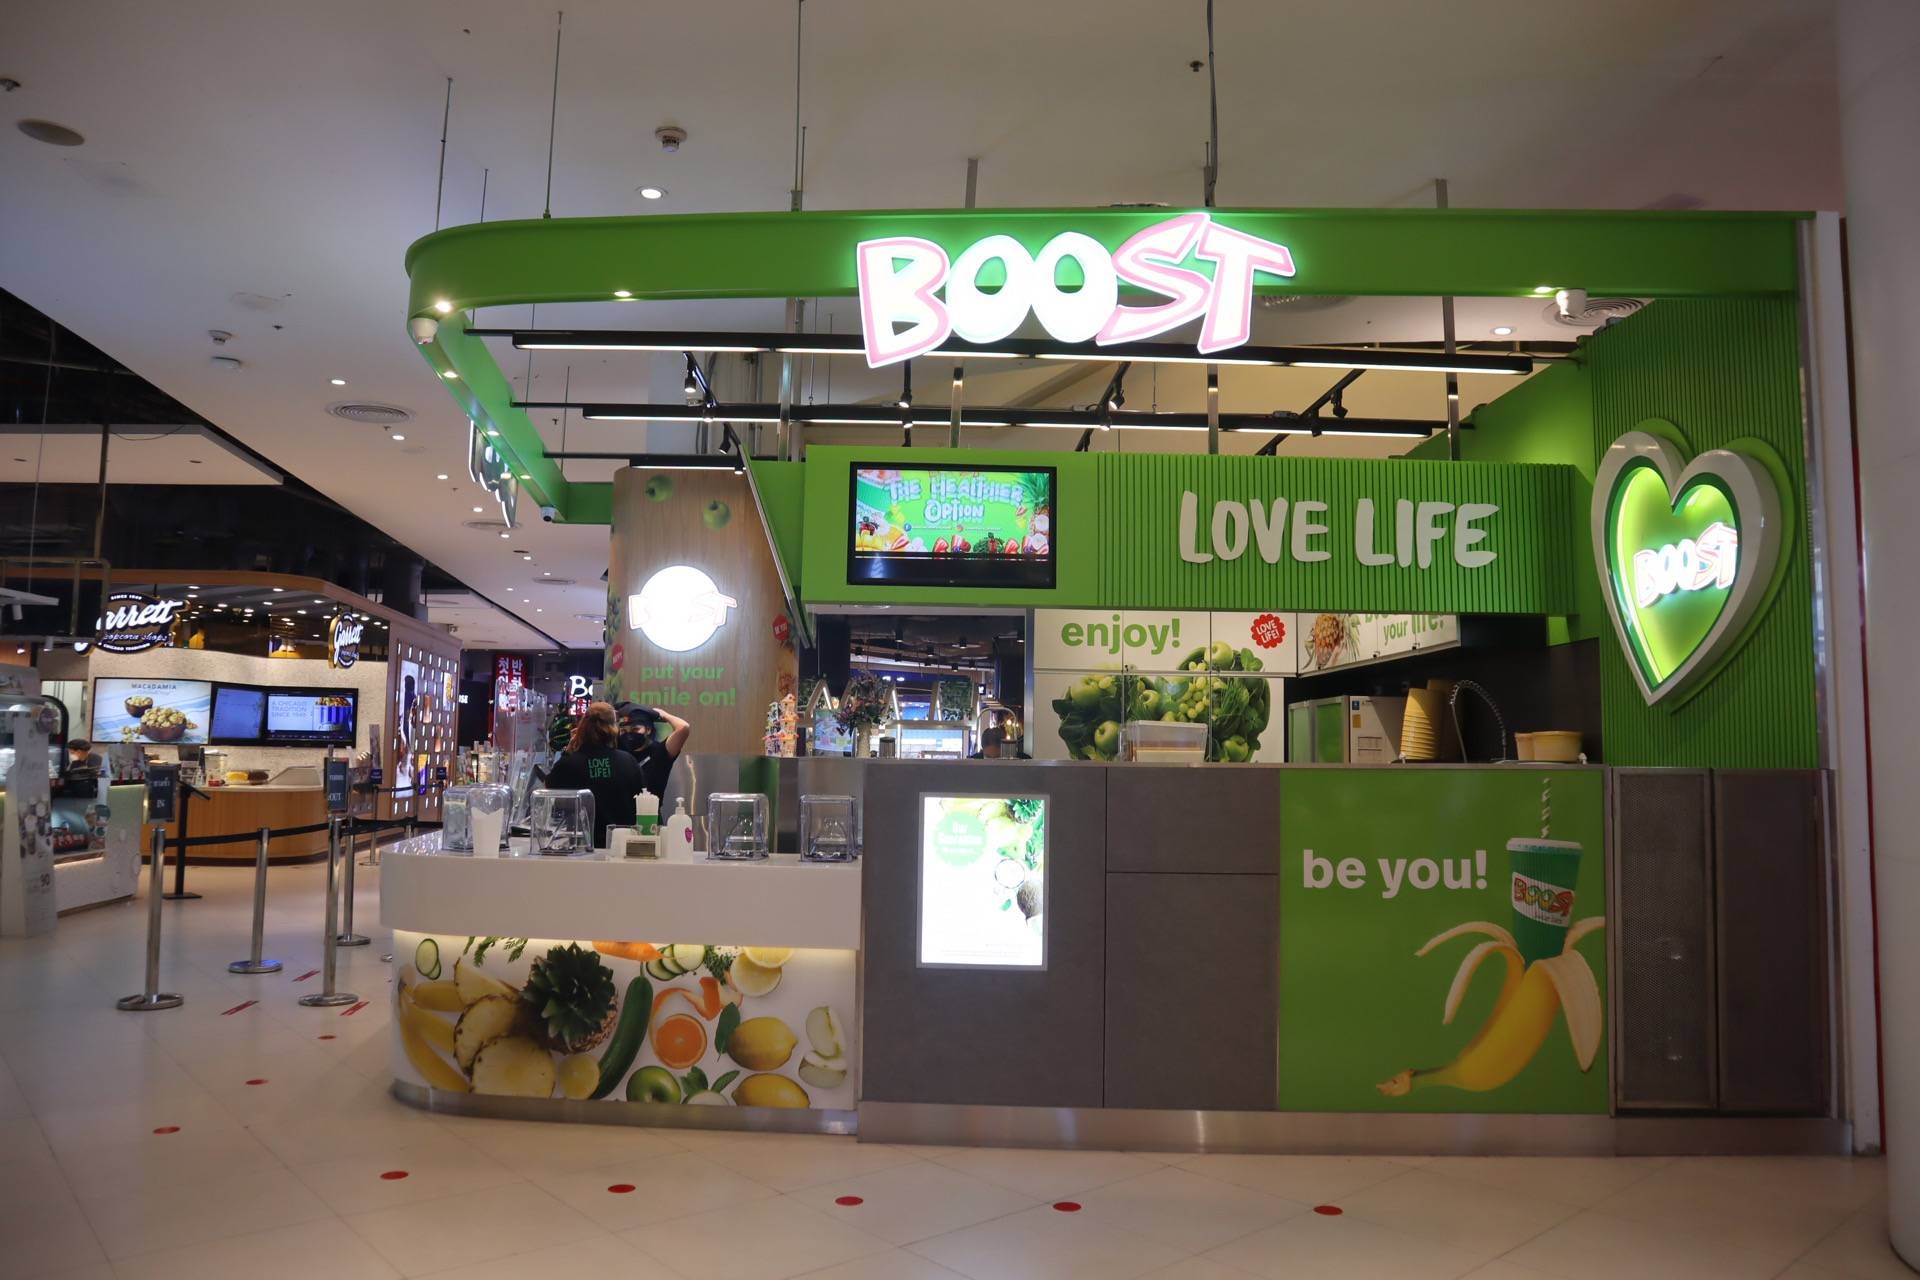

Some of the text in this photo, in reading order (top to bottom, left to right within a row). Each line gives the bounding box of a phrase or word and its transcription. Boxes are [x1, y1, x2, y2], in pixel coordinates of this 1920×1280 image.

[856, 212, 1297, 369] BOOST
[1179, 490, 1500, 570] LOVE LIFE
[1633, 521, 1738, 608] BOOST
[78, 599, 183, 645] arrett
[1061, 613, 1181, 655] enjoy!
[1255, 620, 1278, 635] LOVE
[1383, 620, 1408, 646] your
[1261, 629, 1280, 644] LIFE!
[131, 682, 177, 690] MACADAMIA
[641, 664, 724, 683] put your
[630, 687, 736, 706] smile on!
[588, 757, 611, 769] LOVE
[589, 767, 611, 779] LIFE!
[1303, 849, 1488, 899] be you!
[1513, 877, 1576, 917] BOOST
